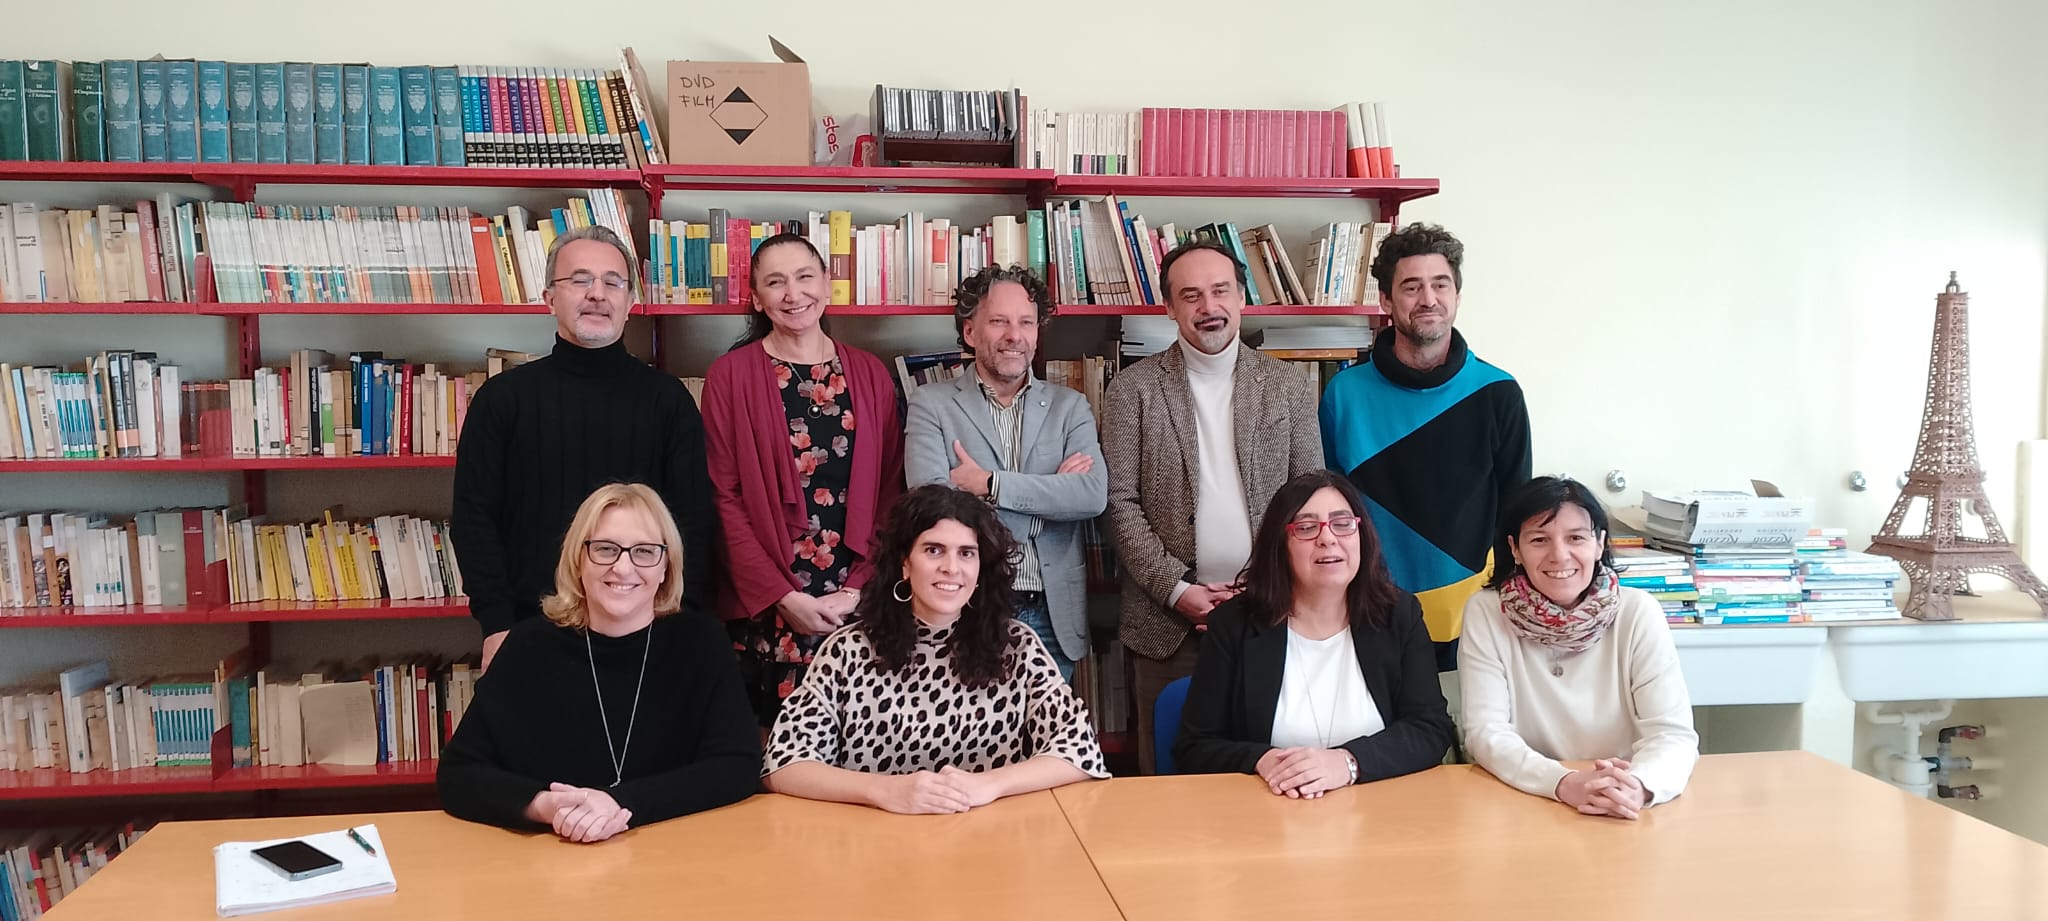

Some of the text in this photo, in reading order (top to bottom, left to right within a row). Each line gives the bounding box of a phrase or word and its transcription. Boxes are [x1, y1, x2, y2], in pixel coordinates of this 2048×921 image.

[680, 74, 715, 89] DVD
[612, 90, 626, 129] QUINDICI
[621, 89, 637, 127] QUINDICI
[1699, 534, 1740, 545] Rizzoli
[1752, 533, 1793, 545] Rizzoli
